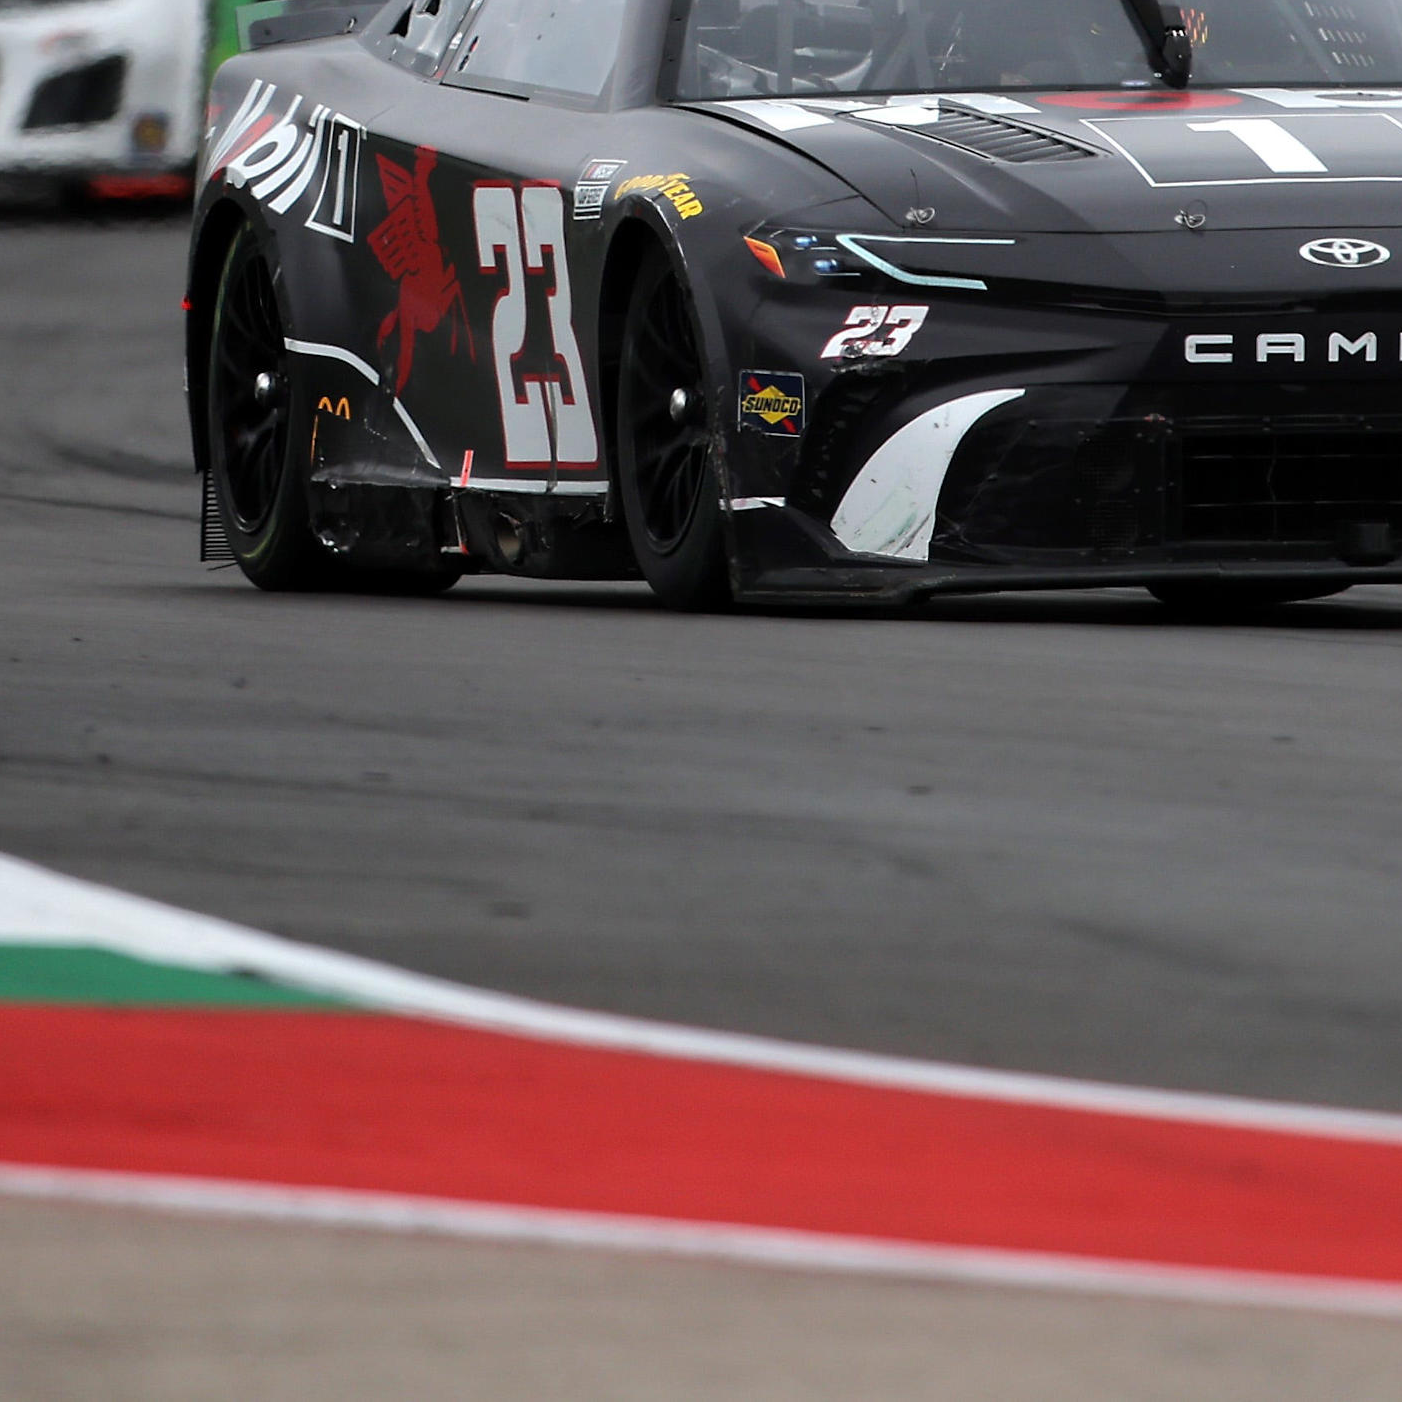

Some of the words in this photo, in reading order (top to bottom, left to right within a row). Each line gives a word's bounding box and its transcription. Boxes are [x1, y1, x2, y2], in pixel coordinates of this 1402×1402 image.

[1185, 118, 1329, 174] 1
[472, 179, 599, 470] 23
[819, 304, 930, 360] 23
[744, 396, 800, 415] SUNOCO
